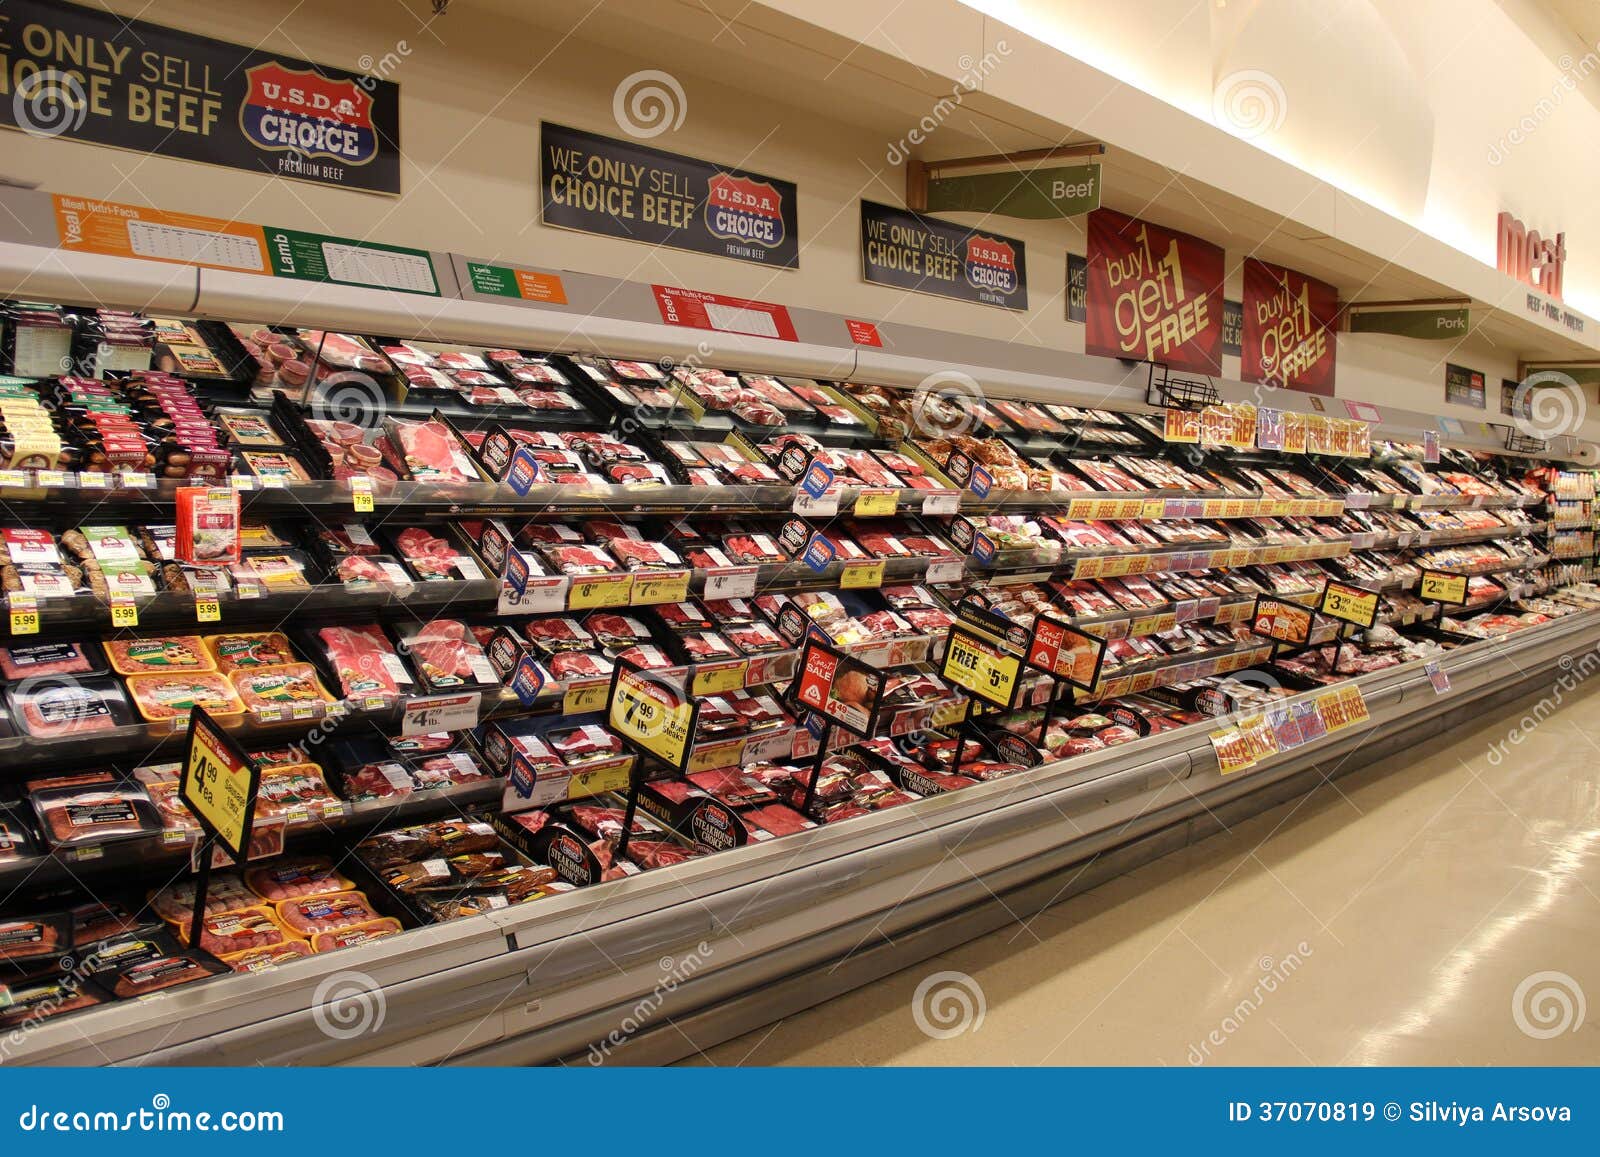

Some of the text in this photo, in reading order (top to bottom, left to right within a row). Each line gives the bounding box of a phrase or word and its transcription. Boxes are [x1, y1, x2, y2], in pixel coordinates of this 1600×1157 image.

[22, 23, 222, 97] ONLY SELL
[128, 83, 222, 136] BEEF
[260, 114, 359, 157] CHOICE
[279, 158, 344, 181] PREMIUM BEEF
[550, 145, 695, 200] WE ONLY SELL
[550, 174, 695, 229] CHOICE BEEF
[716, 187, 775, 212] U.S.D.A.
[1052, 179, 1094, 199] Beef
[62, 198, 85, 211] Meat
[62, 210, 83, 244] Veal
[716, 212, 774, 241] CHOICE
[867, 218, 958, 258] WE ONLY SELL
[273, 233, 297, 274] Lamb
[726, 244, 765, 260] PREMIUM BEEF
[868, 240, 958, 282] CHOICE BEEF
[972, 247, 1011, 264] U.S.D.A.
[1106, 224, 1154, 289] buy 1
[1497, 211, 1567, 305] meat
[972, 266, 1011, 288] CHOICE
[660, 293, 680, 323] Beef
[1115, 239, 1186, 353] get 1
[1256, 294, 1285, 326] buy
[1145, 292, 1210, 362] FREE
[1261, 303, 1303, 379] get
[1298, 281, 1311, 335] 1
[1437, 317, 1465, 329] Pork
[1281, 327, 1327, 387] FREE
[355, 495, 371, 505] 7.99
[1071, 505, 1092, 518] FREE
[1096, 505, 1116, 518] FREE
[1121, 505, 1140, 518] FREE
[1127, 560, 1146, 574] FREE
[14, 614, 36, 626] 5.99
[115, 607, 135, 619] 5.99
[199, 604, 218, 614] 5.99
[1036, 634, 1059, 648] SALE
[951, 646, 979, 670] FREE
[806, 663, 832, 682] SALE
[1321, 703, 1346, 730] FREE
[1342, 697, 1367, 722] FREE
[637, 718, 650, 737] lb.
[662, 725, 684, 742] Steaks
[902, 768, 939, 794] STEAKHOUSE
[908, 780, 930, 796] CHOICE
[203, 786, 215, 807] ea.
[695, 816, 733, 847] STEAKHOUSE
[701, 831, 723, 850] CHOICE
[550, 847, 589, 881] STEAKHOUSE
[557, 863, 579, 885] CHOICE
